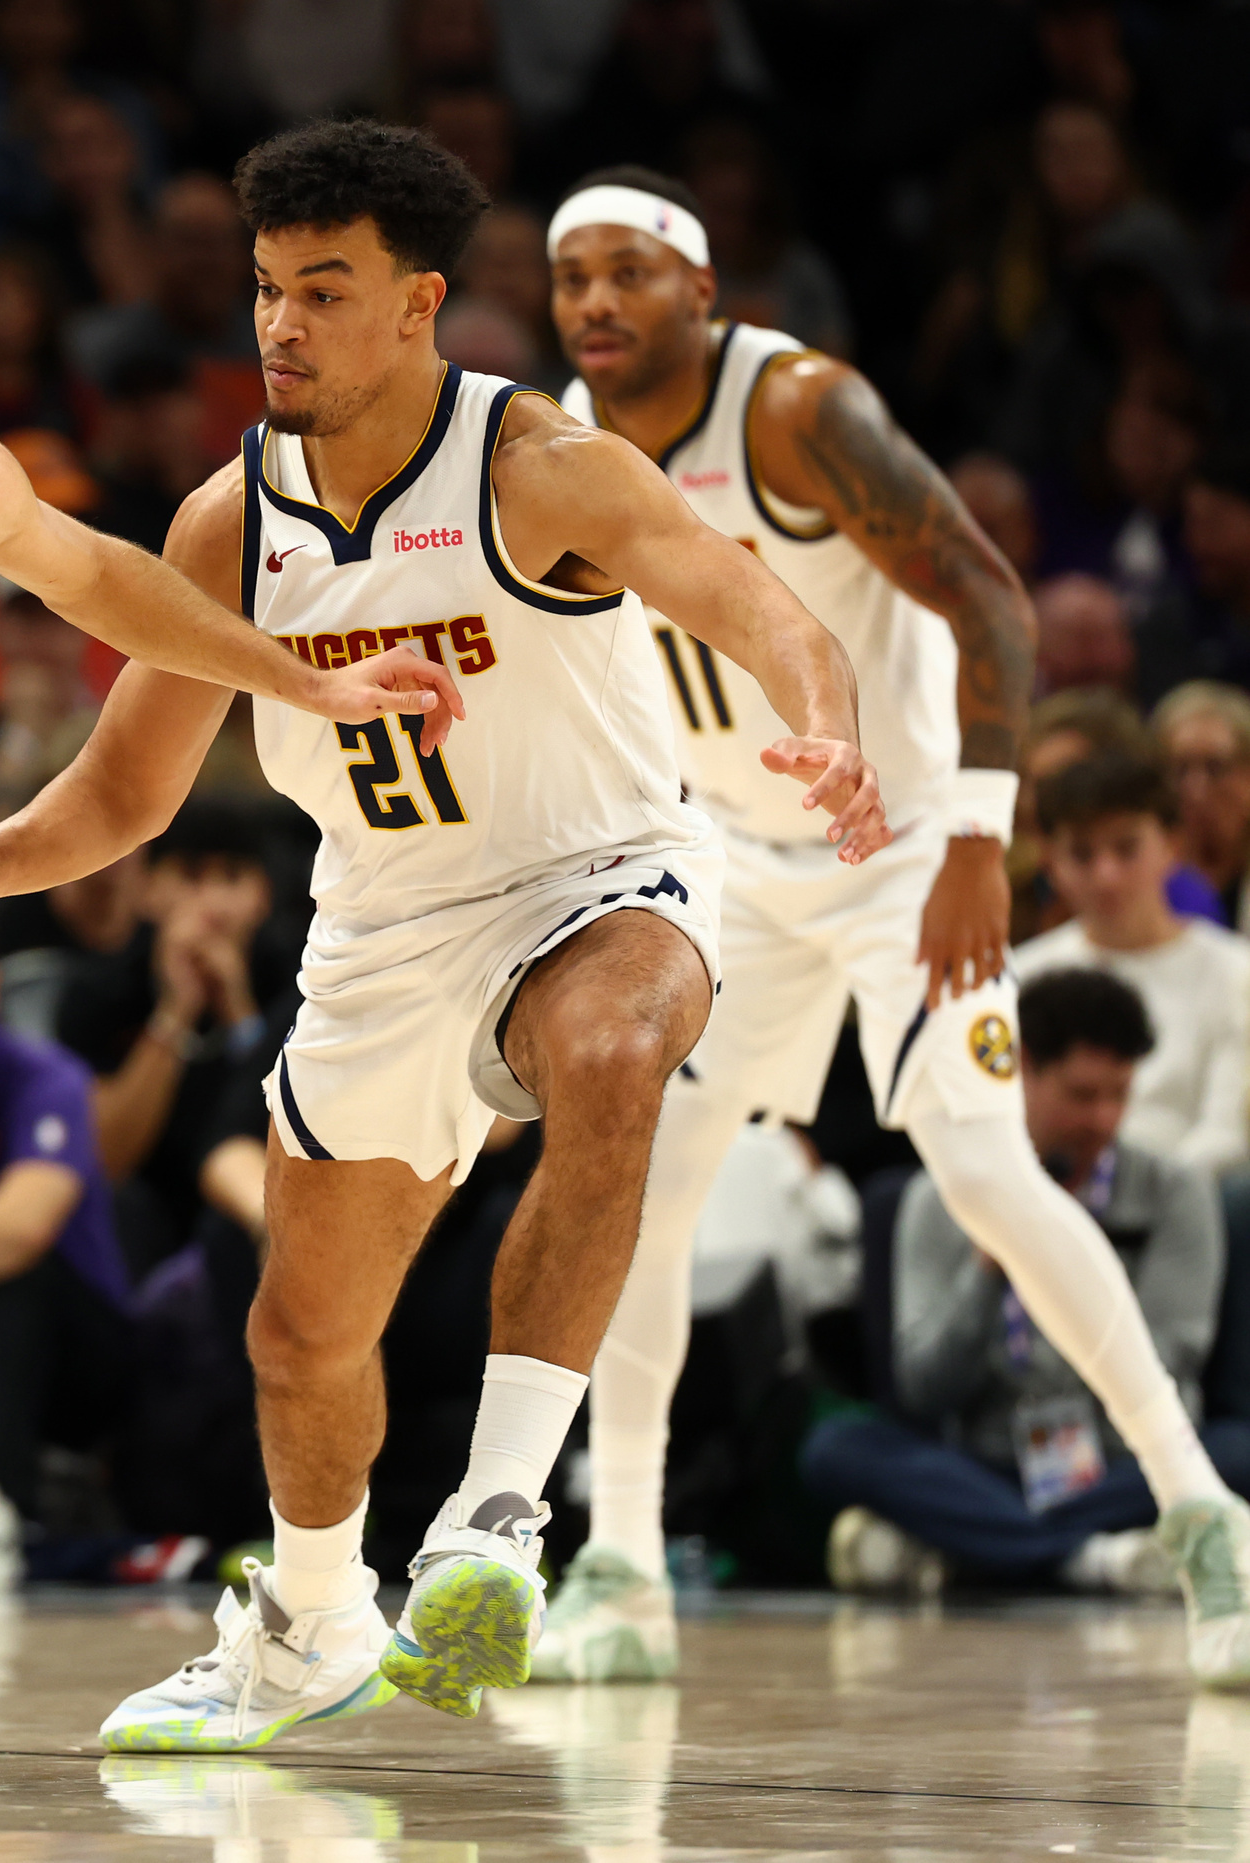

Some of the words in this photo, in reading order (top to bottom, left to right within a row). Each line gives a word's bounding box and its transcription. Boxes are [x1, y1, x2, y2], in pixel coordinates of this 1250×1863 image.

[393, 527, 463, 553] ibotta
[274, 613, 498, 676] GGTS
[651, 625, 734, 732] 11
[332, 711, 470, 831] 21
